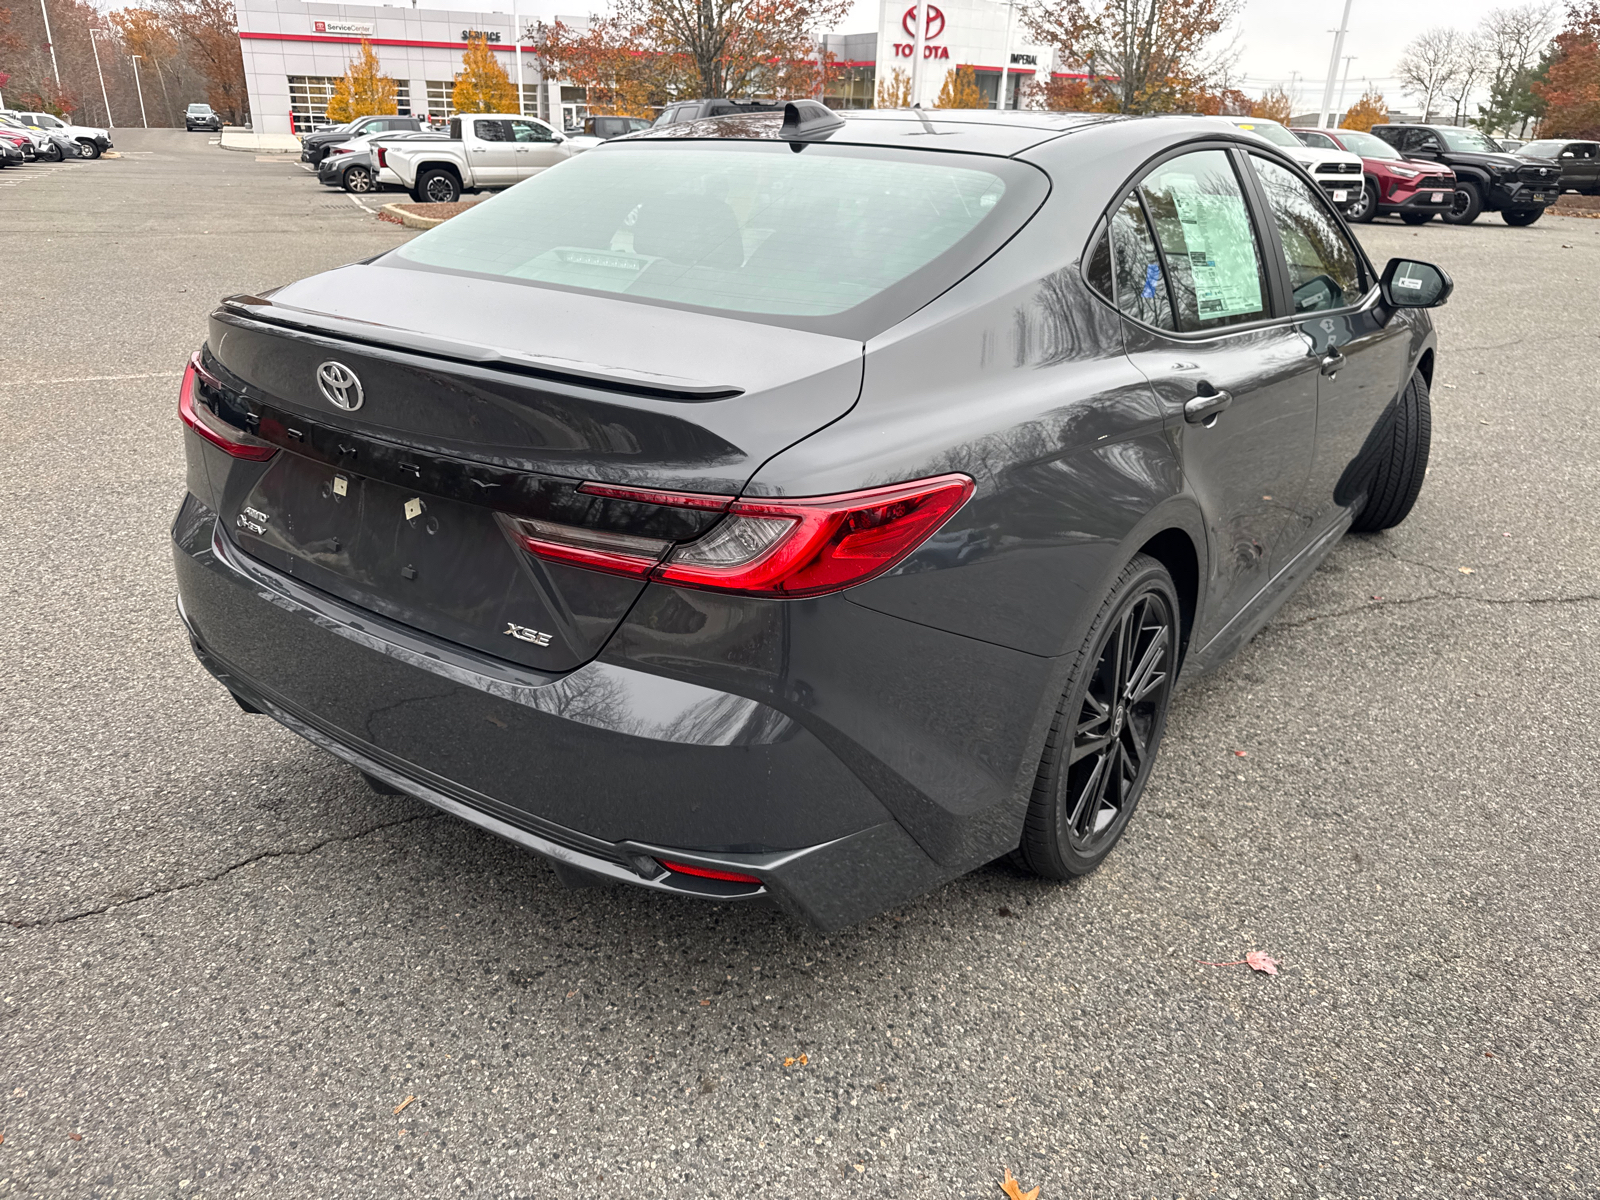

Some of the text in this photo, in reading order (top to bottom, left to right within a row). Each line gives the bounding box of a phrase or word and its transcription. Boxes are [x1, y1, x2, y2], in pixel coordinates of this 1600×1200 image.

[327, 23, 370, 32] ServiceCenter
[893, 43, 949, 59] TOOTA
[1010, 53, 1037, 65] IMPERIAL
[244, 506, 269, 523] AWD
[503, 622, 553, 647] XSE
